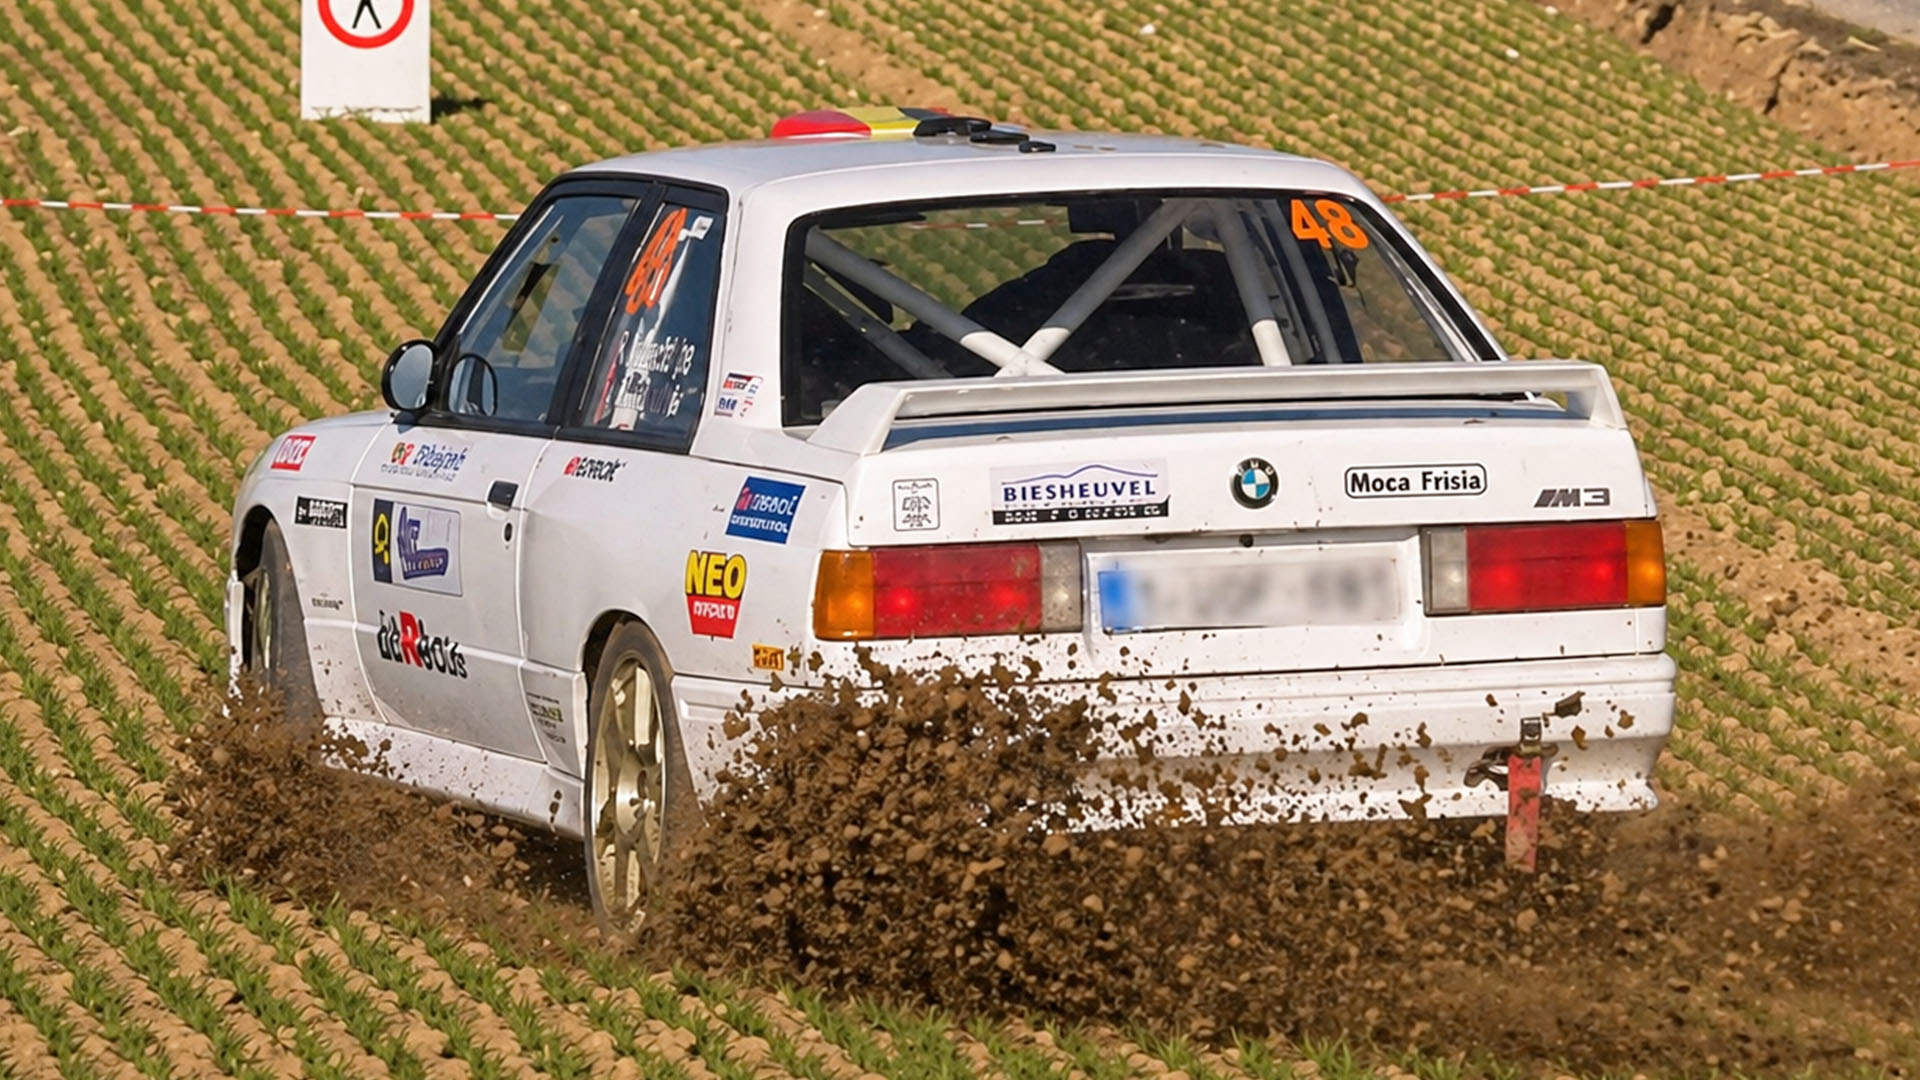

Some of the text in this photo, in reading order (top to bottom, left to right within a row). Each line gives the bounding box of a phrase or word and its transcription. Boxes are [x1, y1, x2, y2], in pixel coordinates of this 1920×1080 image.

[1291, 199, 1369, 249] 48
[1003, 480, 1157, 502] BIESHEUVEL
[1350, 470, 1481, 493] Moca Frisia
[1535, 487, 1610, 508] M3
[685, 549, 747, 600] NEO
